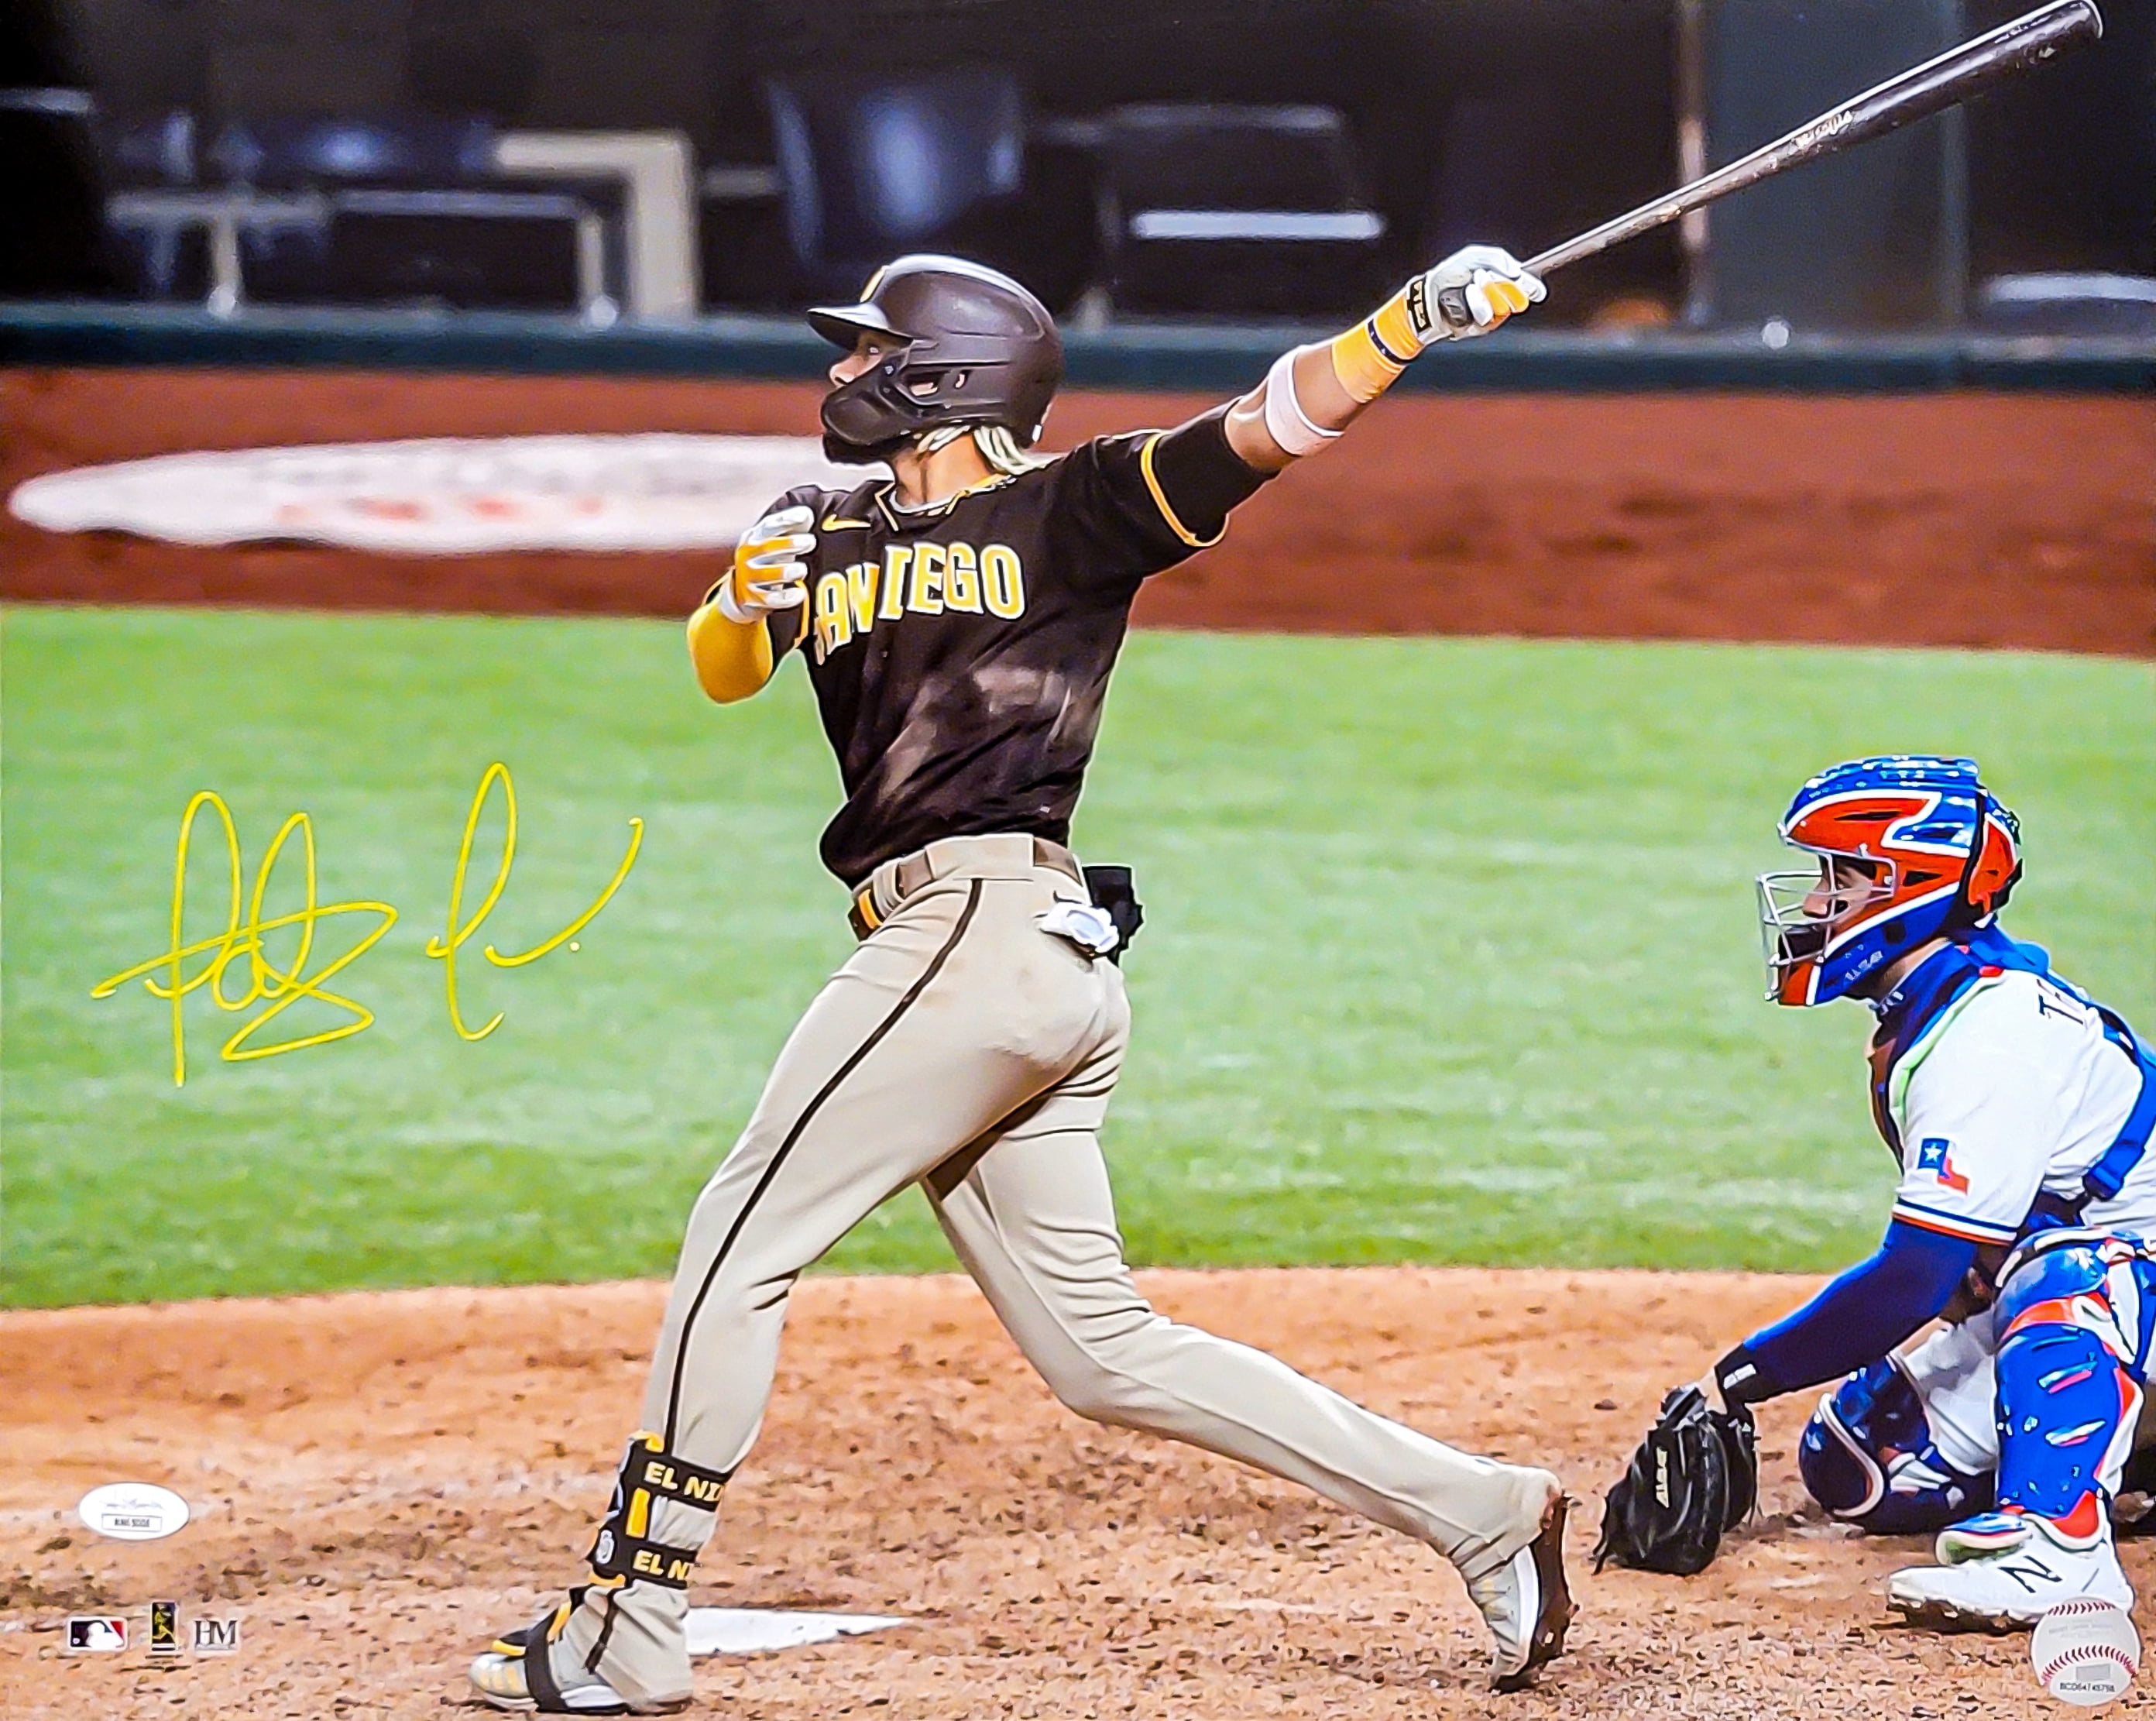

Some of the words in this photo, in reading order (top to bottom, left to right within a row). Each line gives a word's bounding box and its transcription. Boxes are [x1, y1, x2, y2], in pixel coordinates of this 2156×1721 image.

[814, 562, 880, 666] AN
[877, 541, 1025, 620] IEGO
[644, 1462, 678, 1490] EL
[684, 1476, 723, 1502] NI
[633, 1550, 664, 1575] EL
[668, 1559, 694, 1580] N
